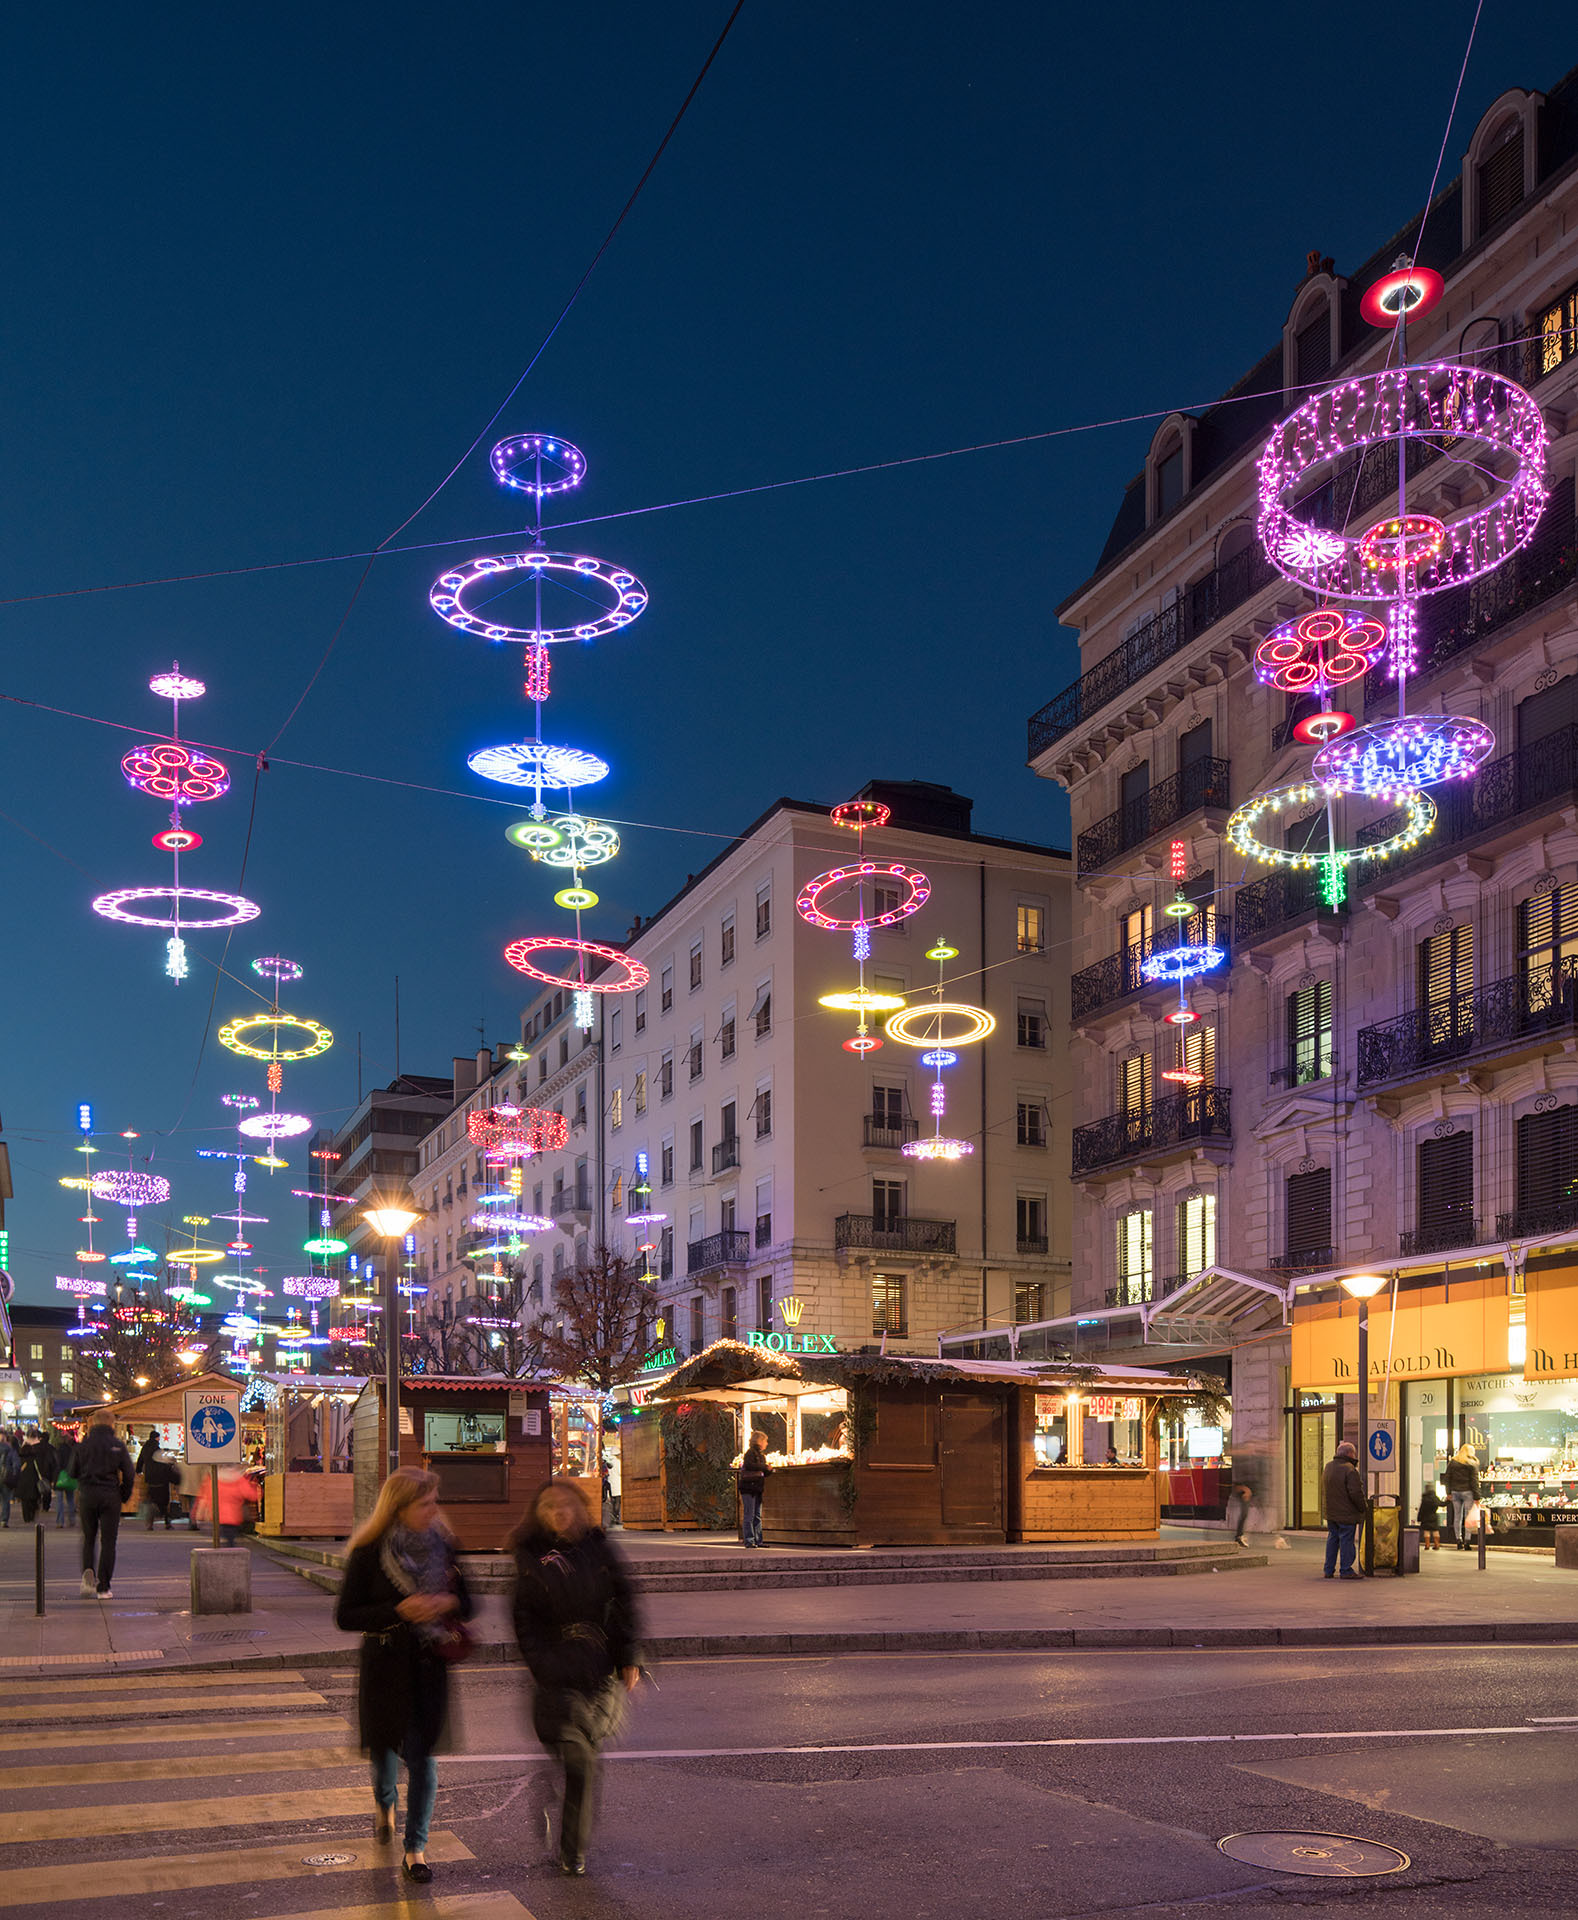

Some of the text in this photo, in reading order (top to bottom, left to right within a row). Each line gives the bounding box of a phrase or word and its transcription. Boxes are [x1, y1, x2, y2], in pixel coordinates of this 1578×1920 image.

[746, 1331, 838, 1354] ROLEX
[644, 1346, 677, 1370] ROLEX
[1356, 1356, 1431, 1376] AROLD
[1466, 1379, 1515, 1391] WATCHES
[199, 1394, 226, 1404] ZONE
[1421, 1393, 1433, 1404] 20
[1460, 1400, 1485, 1408] SEIKO
[1506, 1513, 1532, 1521] VENTE
